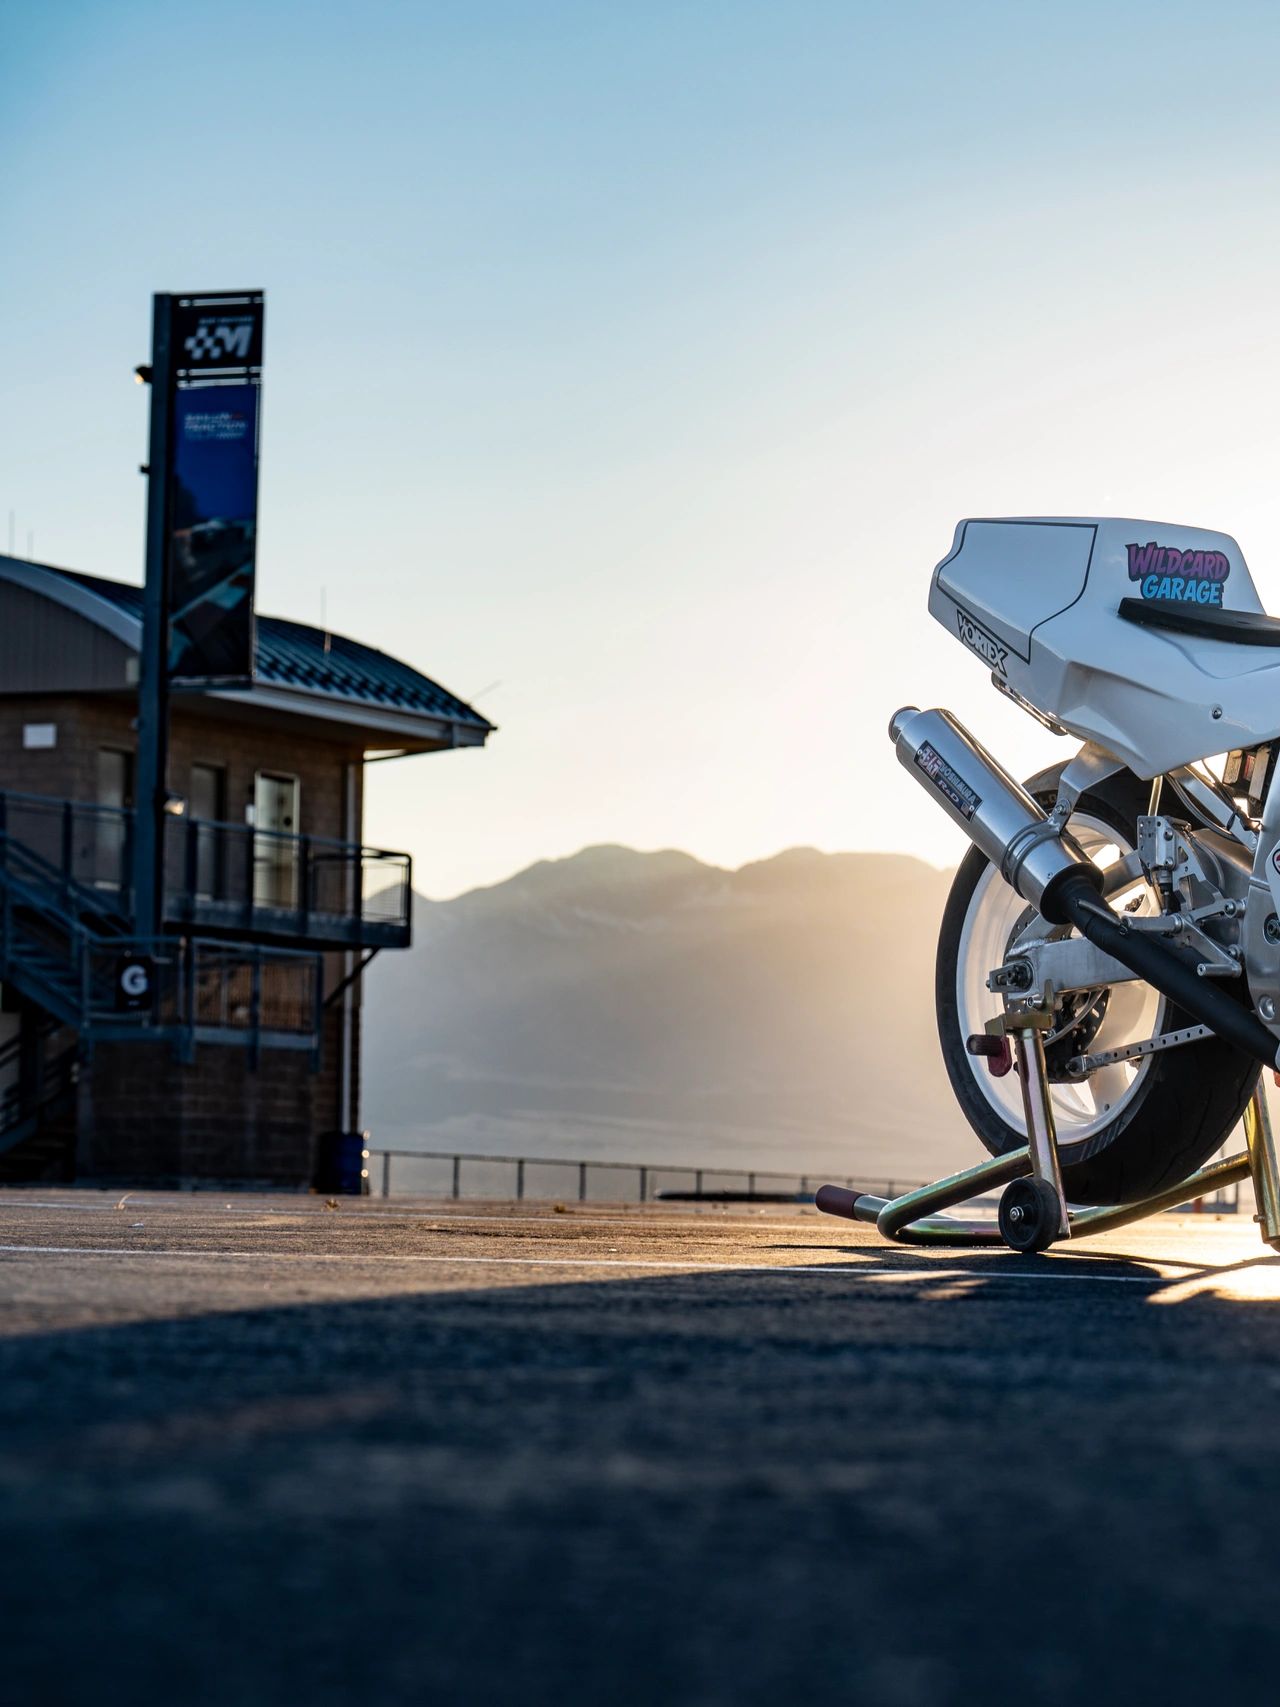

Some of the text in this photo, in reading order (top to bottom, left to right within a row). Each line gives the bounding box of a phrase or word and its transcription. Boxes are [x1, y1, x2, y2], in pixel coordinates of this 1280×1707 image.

[1126, 542, 1229, 581] WILDCARD
[1142, 574, 1222, 604] GARAGE
[957, 609, 1008, 678] VORTEX
[121, 965, 148, 996] G
